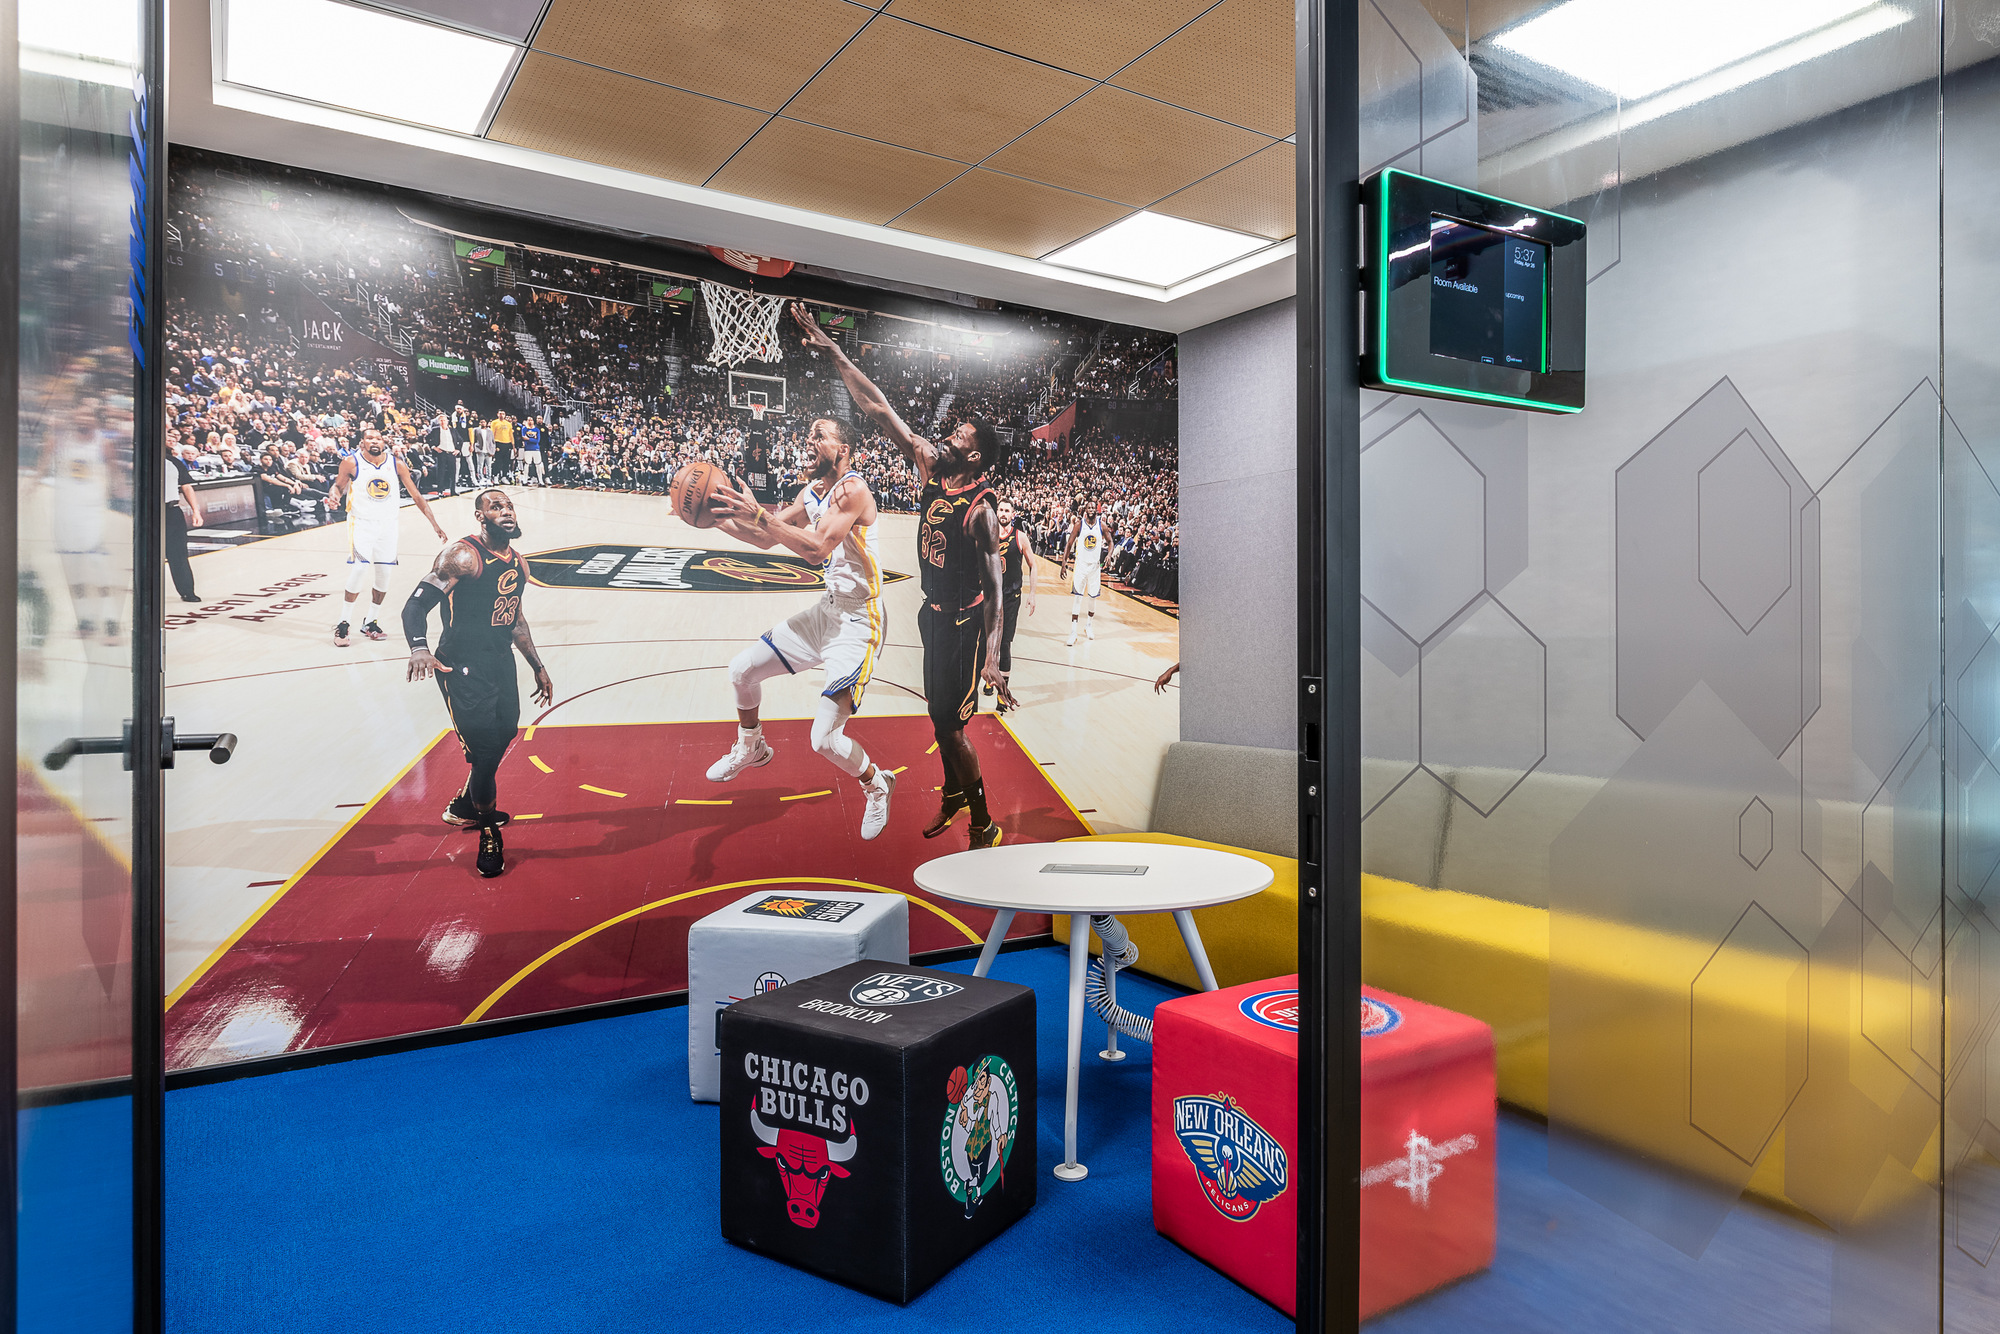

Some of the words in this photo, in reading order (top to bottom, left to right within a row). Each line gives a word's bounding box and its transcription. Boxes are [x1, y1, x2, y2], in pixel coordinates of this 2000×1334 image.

[1514, 246, 1535, 262] 5:37
[1433, 276, 1453, 288] Room
[1452, 280, 1479, 294] Available
[1505, 292, 1525, 302] upcoming
[307, 343, 342, 351] ENTERTAINMENT
[428, 358, 469, 374] Huntington
[682, 468, 704, 515] SPALDING
[921, 522, 947, 569] 32
[607, 547, 707, 590] CAVALIERS
[233, 572, 328, 598] Loans
[229, 592, 331, 623] Arena
[490, 595, 520, 627] 23
[816, 901, 859, 921] SUNS
[863, 975, 955, 997] NETS
[797, 998, 893, 1024] BROOKLYN
[744, 1052, 869, 1106] CHICAGO
[760, 1086, 847, 1133] BULLS
[999, 1062, 1018, 1140] CELTICS
[941, 1108, 961, 1195] BOSTON
[1176, 1100, 1210, 1131] NEW
[1214, 1108, 1285, 1184] ORLEANS
[1205, 1180, 1250, 1213] PELICANS
